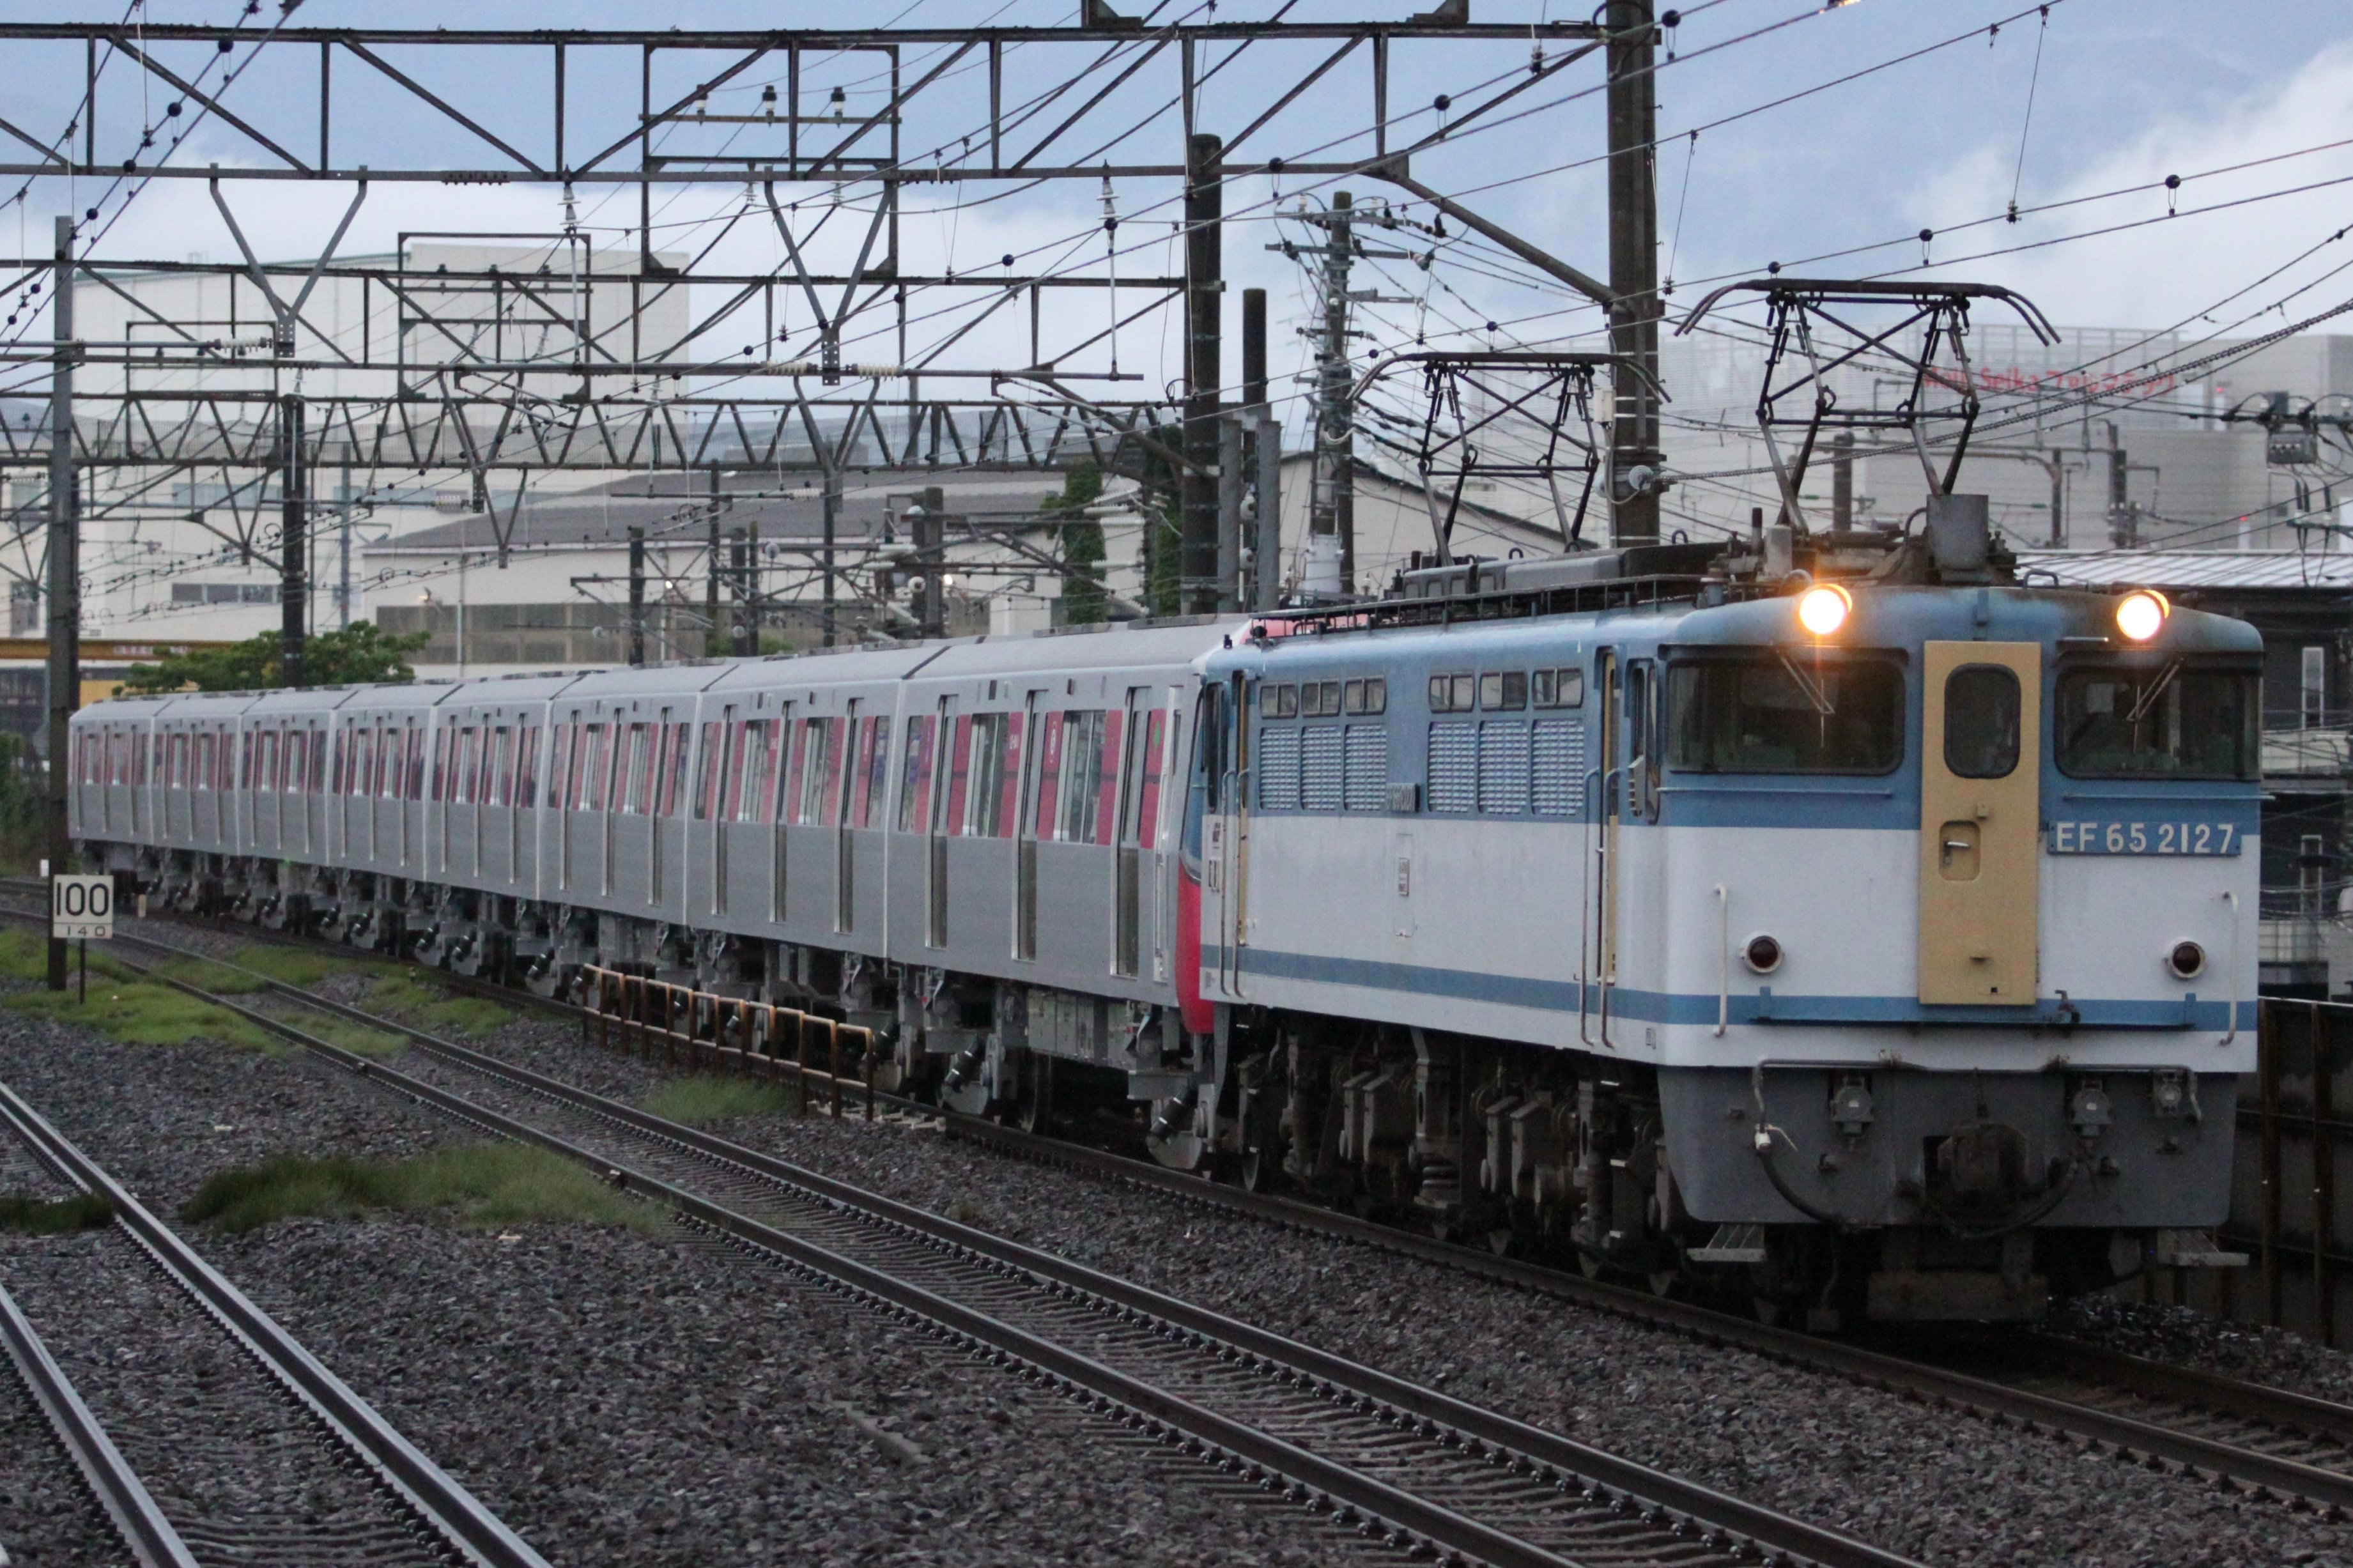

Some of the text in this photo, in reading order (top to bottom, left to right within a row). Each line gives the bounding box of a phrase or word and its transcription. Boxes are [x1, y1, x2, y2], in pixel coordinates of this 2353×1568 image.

[2056, 822, 2234, 854] EF 65 2127
[56, 882, 109, 916] 100
